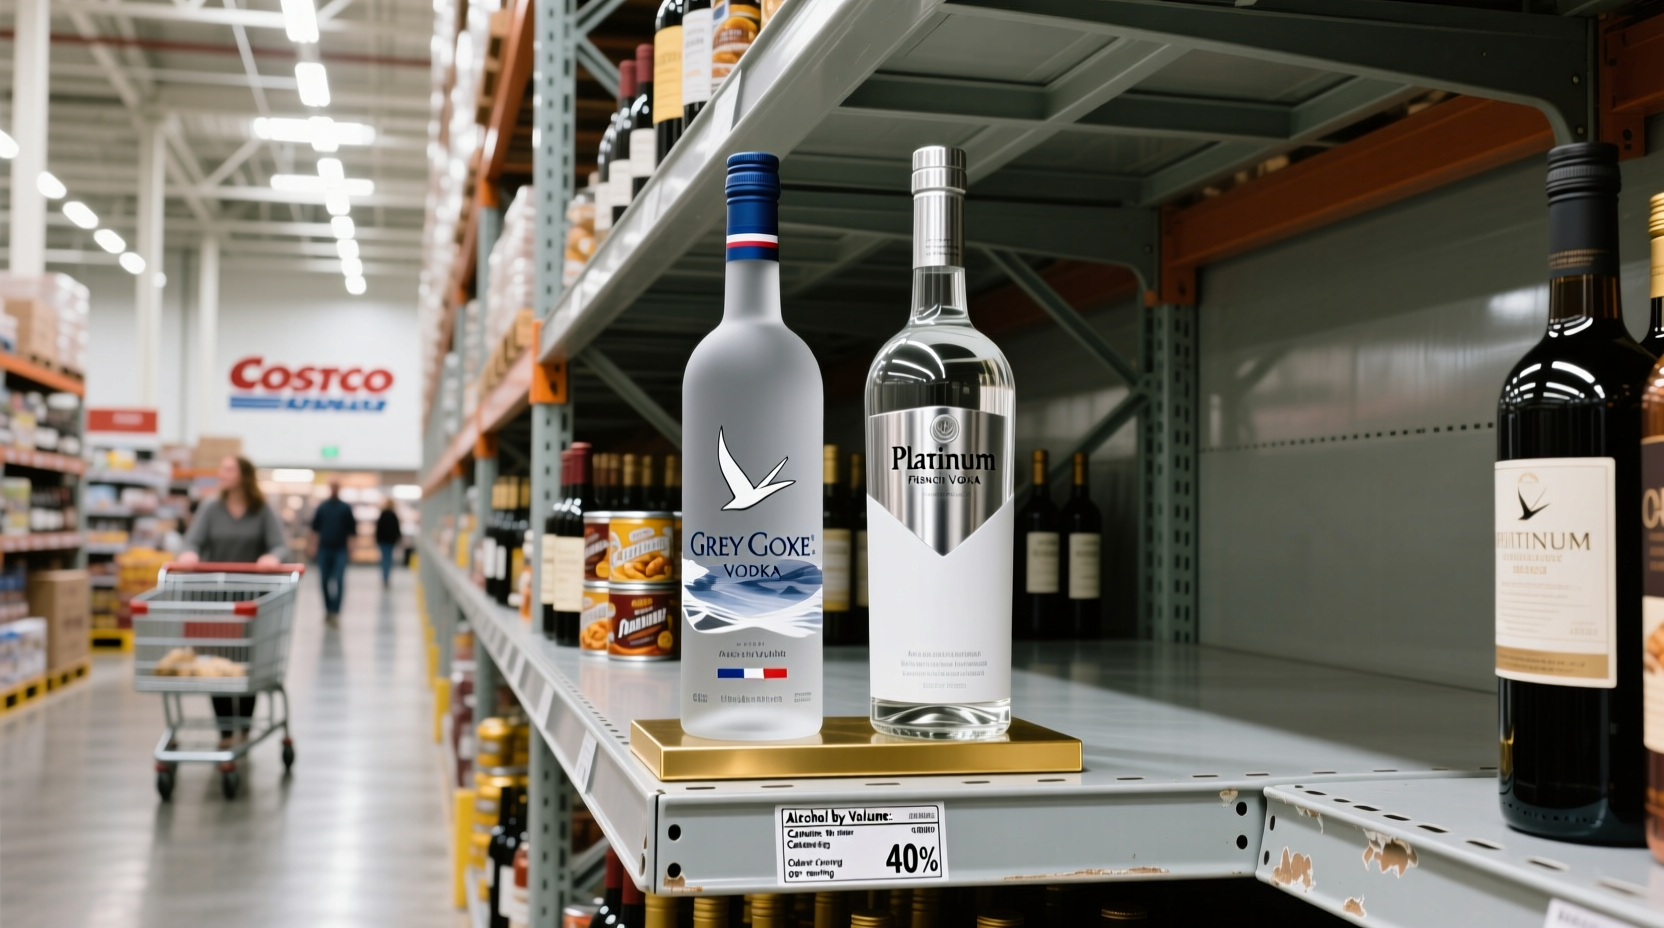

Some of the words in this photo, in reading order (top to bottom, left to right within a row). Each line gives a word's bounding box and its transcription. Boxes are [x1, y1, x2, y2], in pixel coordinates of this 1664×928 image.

[892, 445, 996, 471] Platinum
[690, 531, 744, 557] GREY
[724, 563, 782, 578] VODKA
[831, 809, 846, 826] by
[886, 843, 939, 874] 40%
